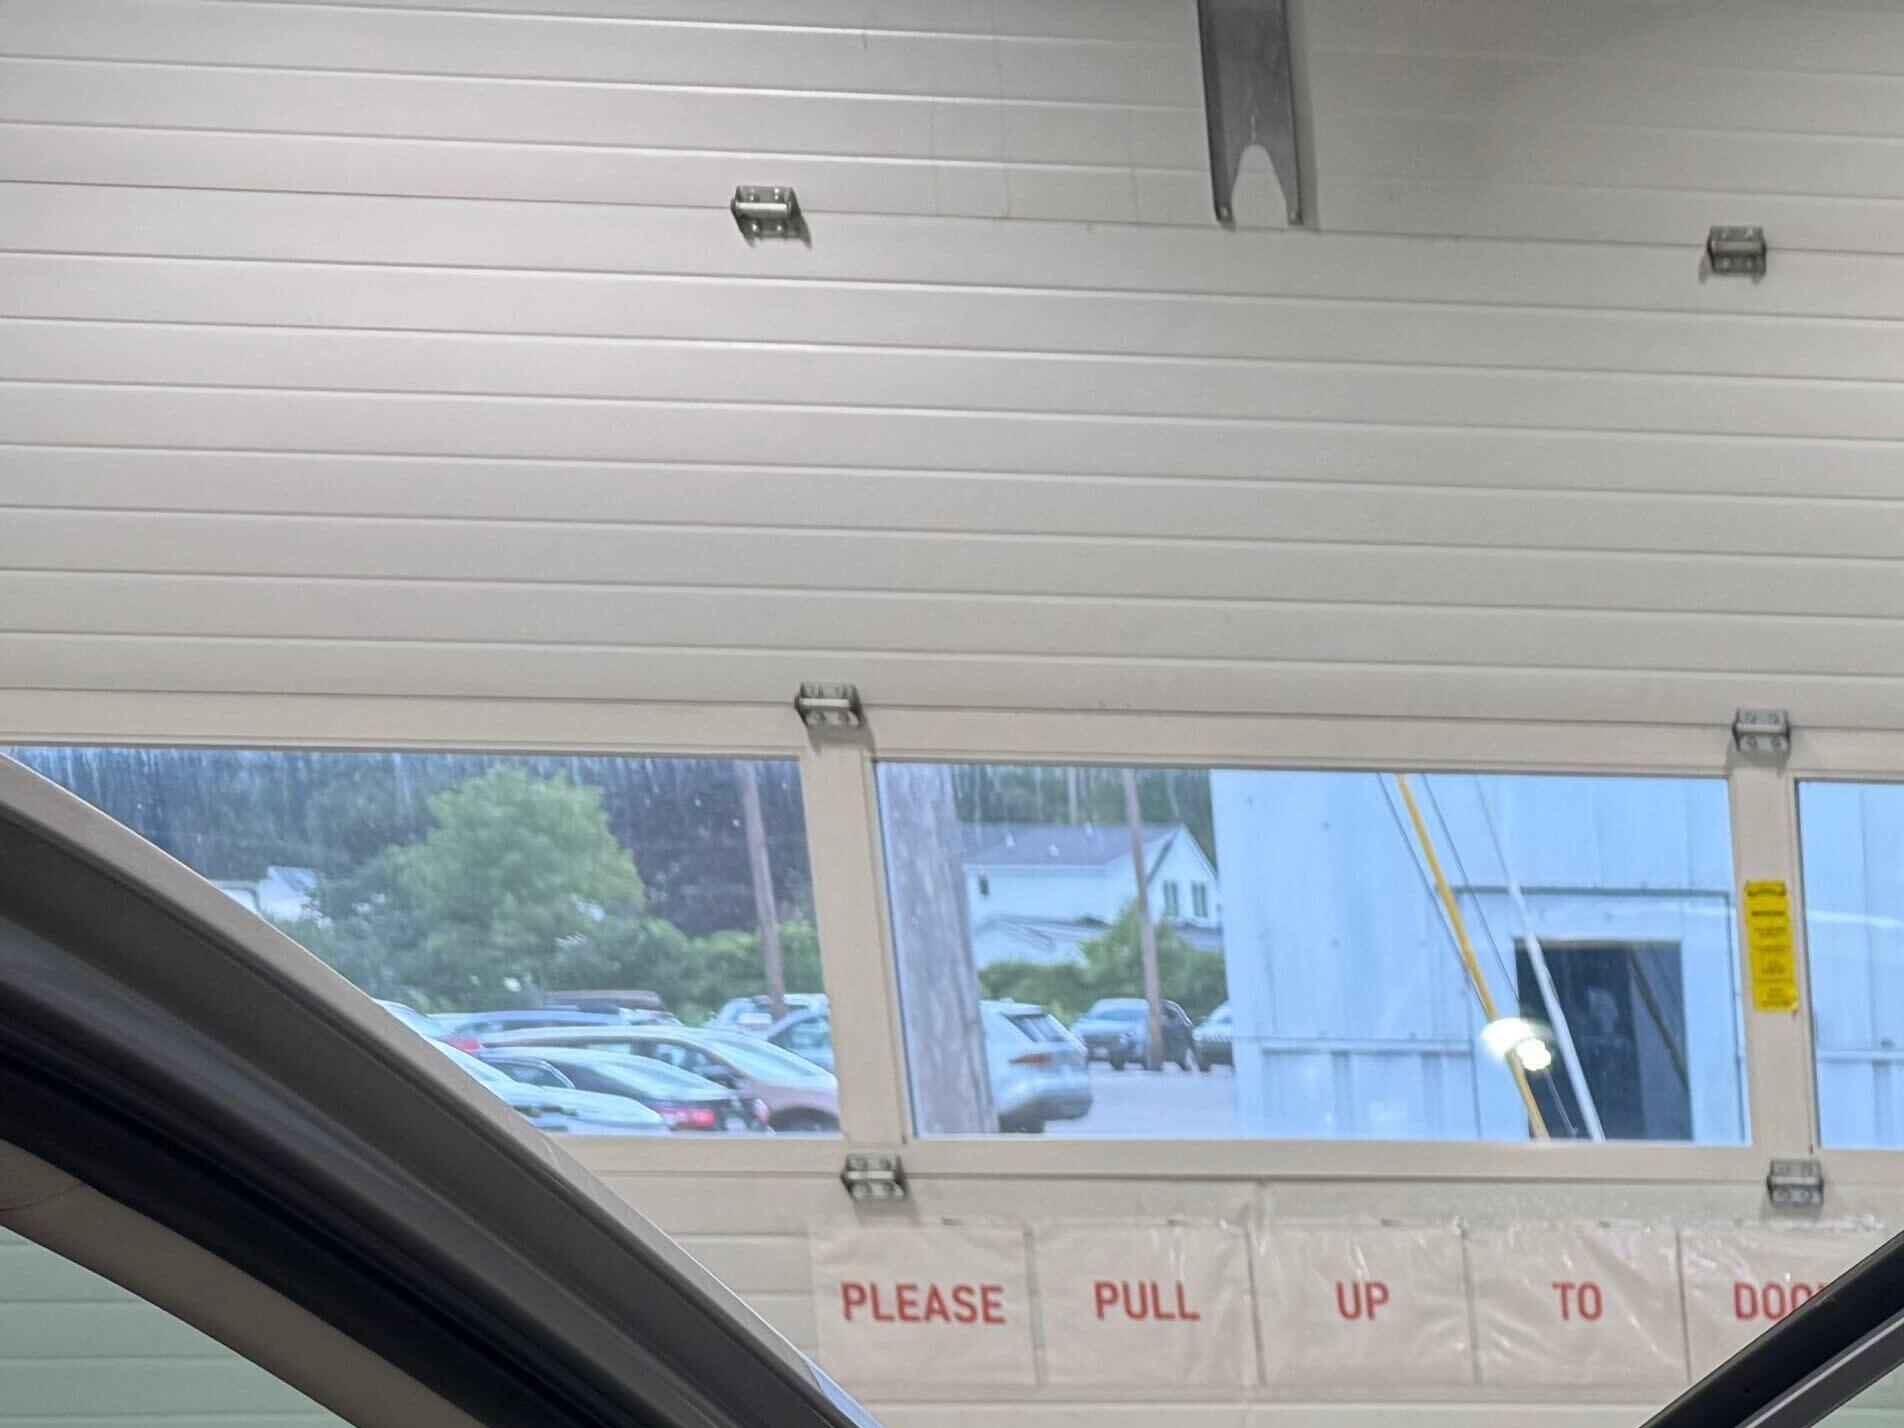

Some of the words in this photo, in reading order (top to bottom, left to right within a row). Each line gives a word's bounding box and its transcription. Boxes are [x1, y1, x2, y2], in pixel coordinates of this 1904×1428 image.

[840, 1281, 1006, 1325] PLEASE
[1093, 1280, 1200, 1322] PULL
[1336, 1280, 1390, 1322] UP
[1552, 1280, 1603, 1322] TO
[1733, 1281, 1825, 1324] DOO
